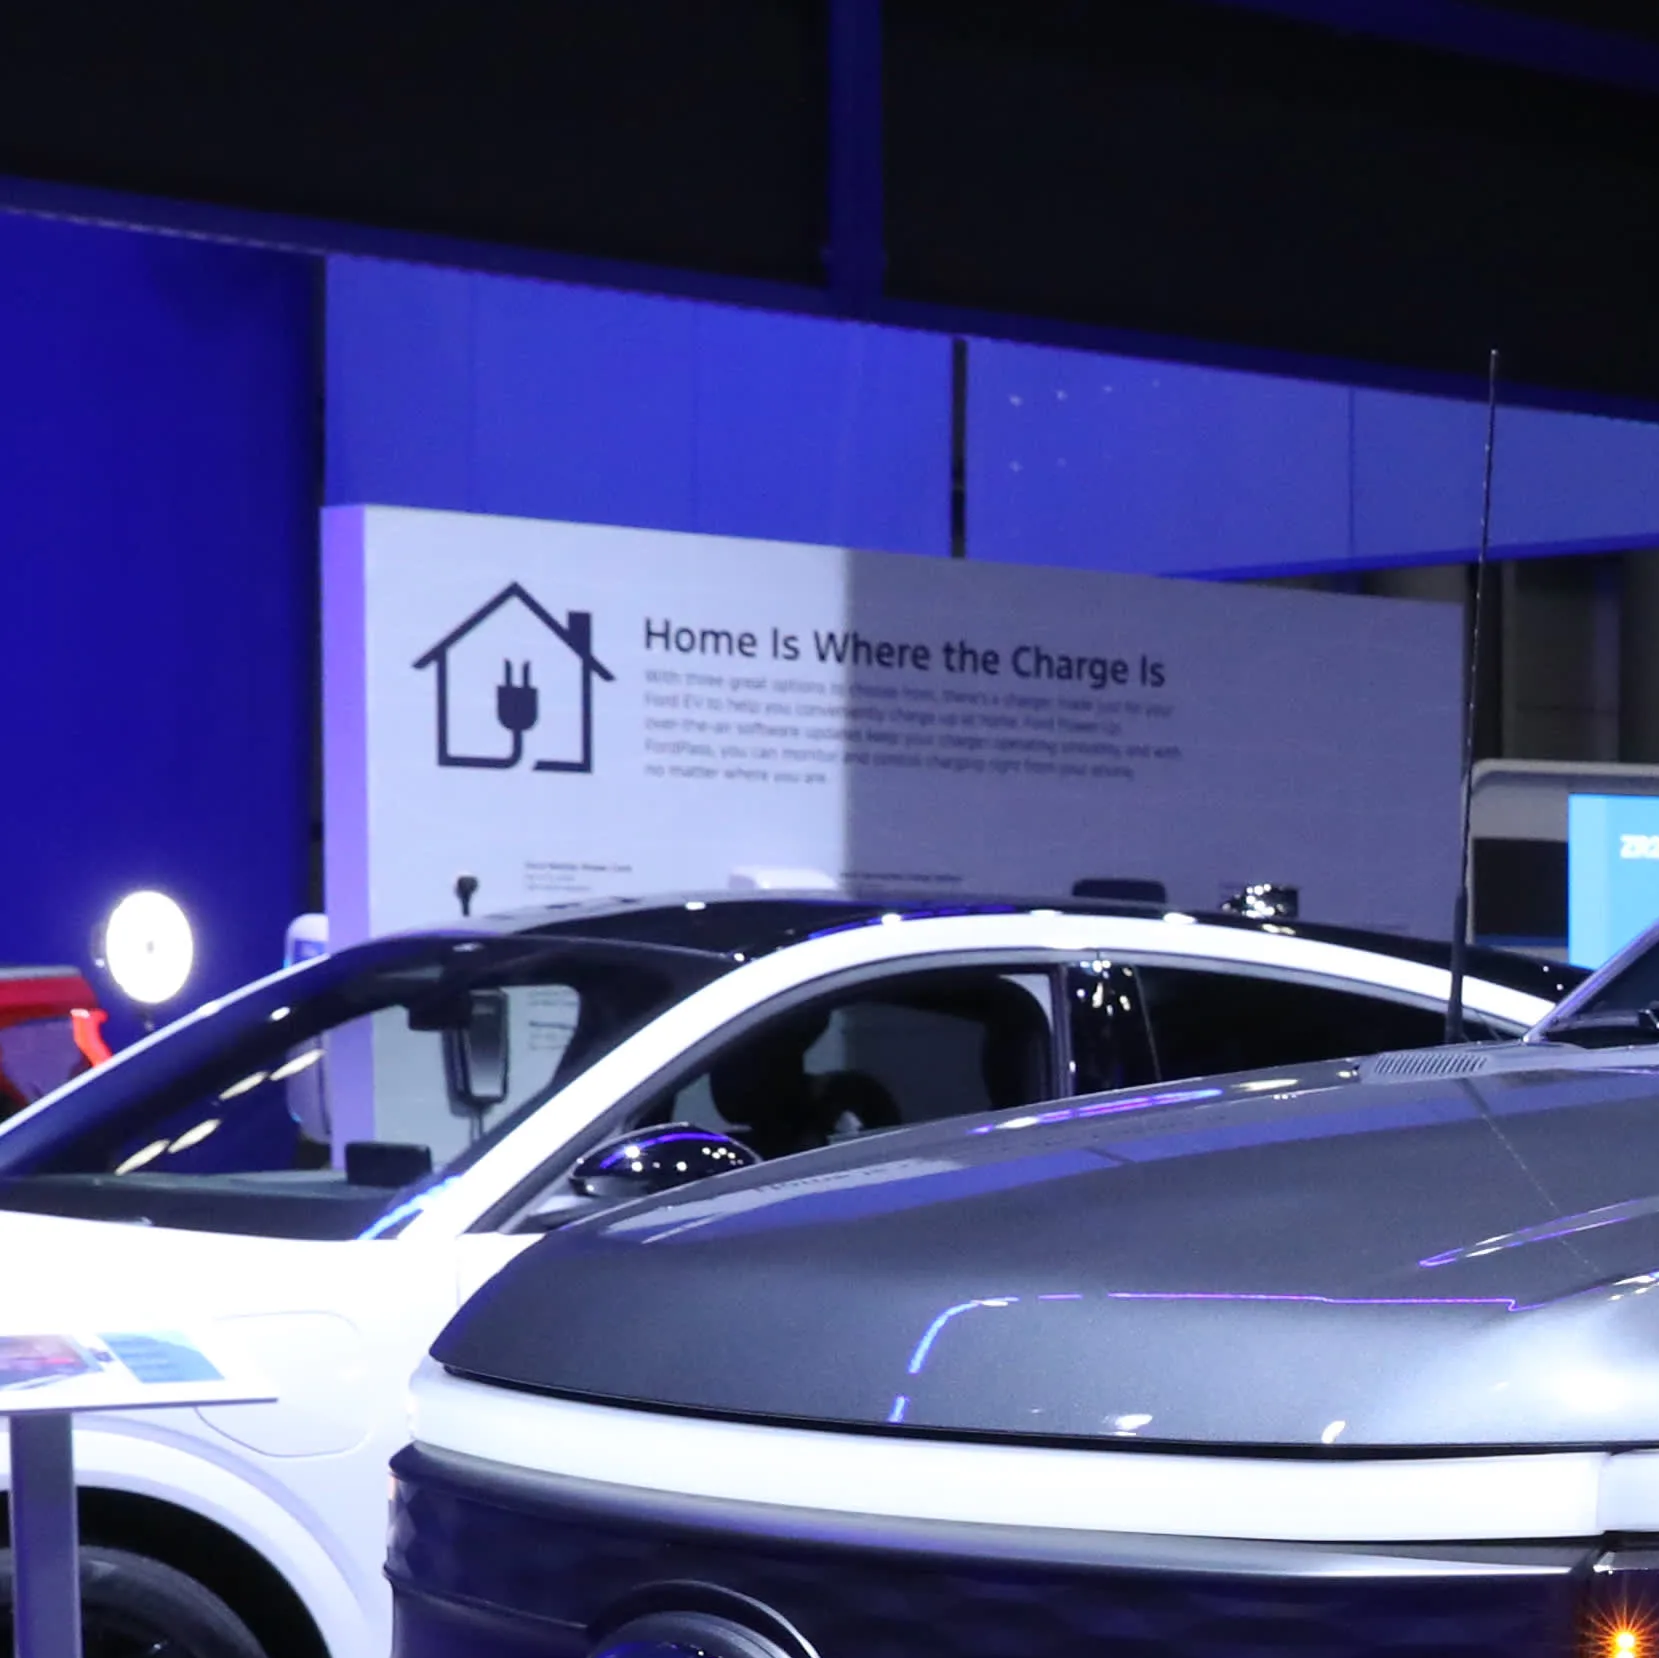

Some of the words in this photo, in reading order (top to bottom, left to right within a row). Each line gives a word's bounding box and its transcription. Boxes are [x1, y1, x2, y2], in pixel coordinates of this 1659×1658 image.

[644, 617, 758, 658] Home
[772, 627, 801, 661] Is
[813, 630, 931, 670] Where
[943, 639, 1000, 676] the
[1011, 645, 1129, 690] Charge
[1139, 654, 1166, 688] Is
